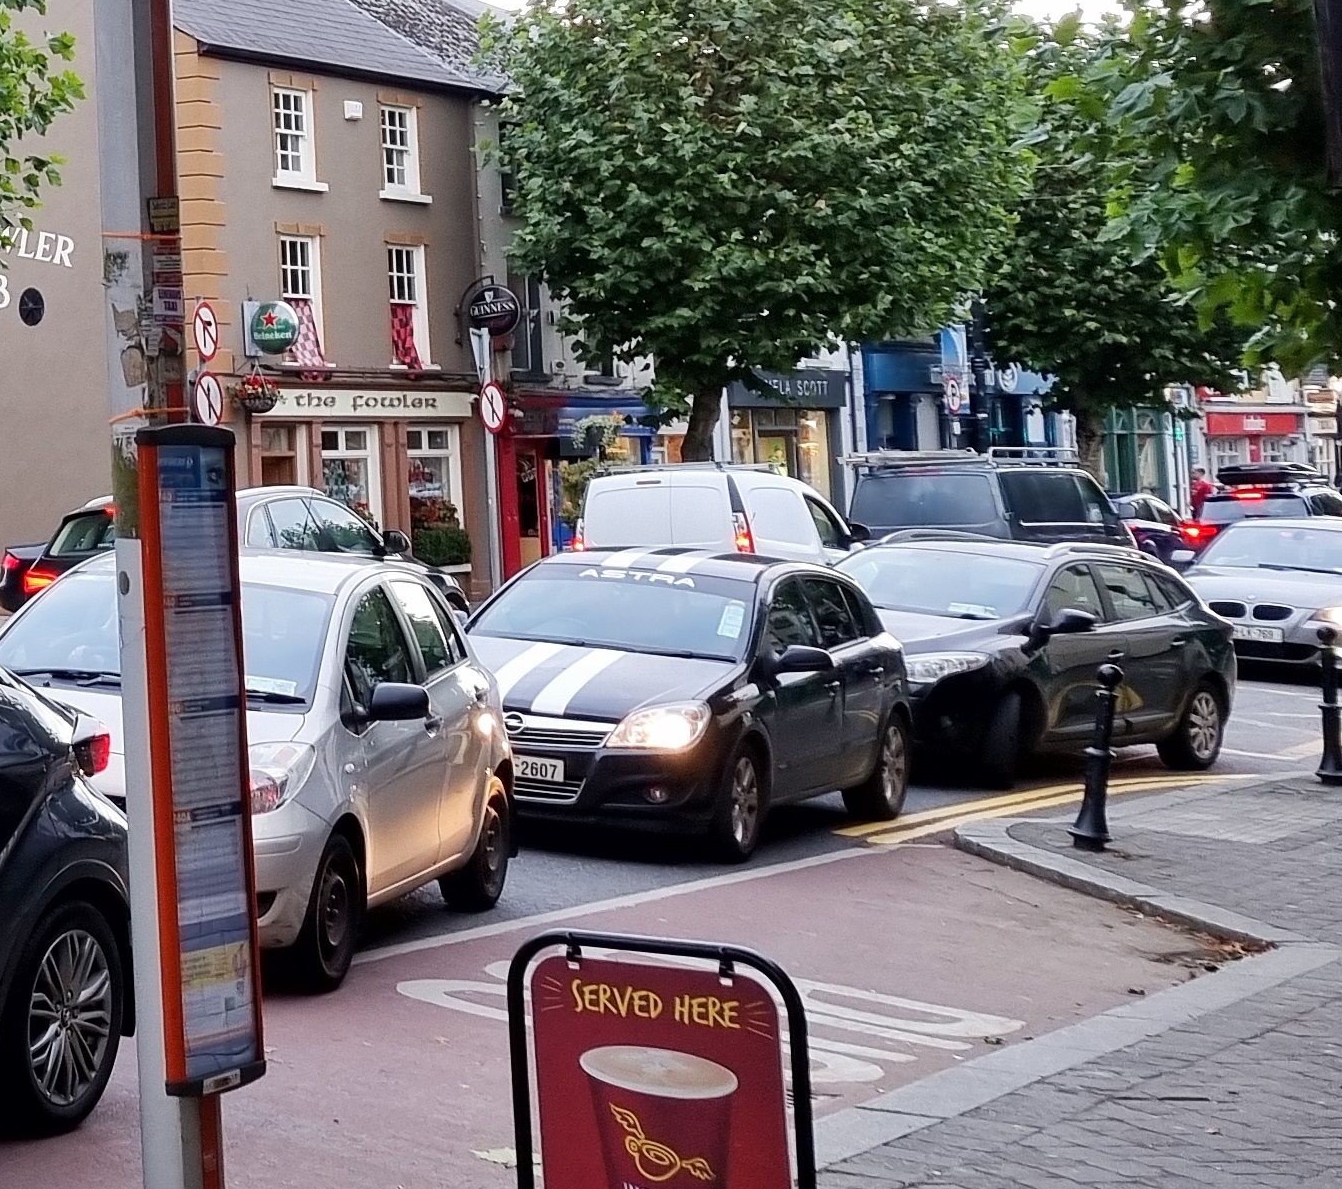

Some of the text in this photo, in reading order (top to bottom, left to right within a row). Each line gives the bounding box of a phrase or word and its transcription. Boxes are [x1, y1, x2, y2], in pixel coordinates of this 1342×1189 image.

[470, 302, 516, 318] GUINNESS
[797, 379, 829, 397] SCOTT
[578, 568, 696, 588] ASTRA
[570, 978, 741, 1030] SERVED HERE
